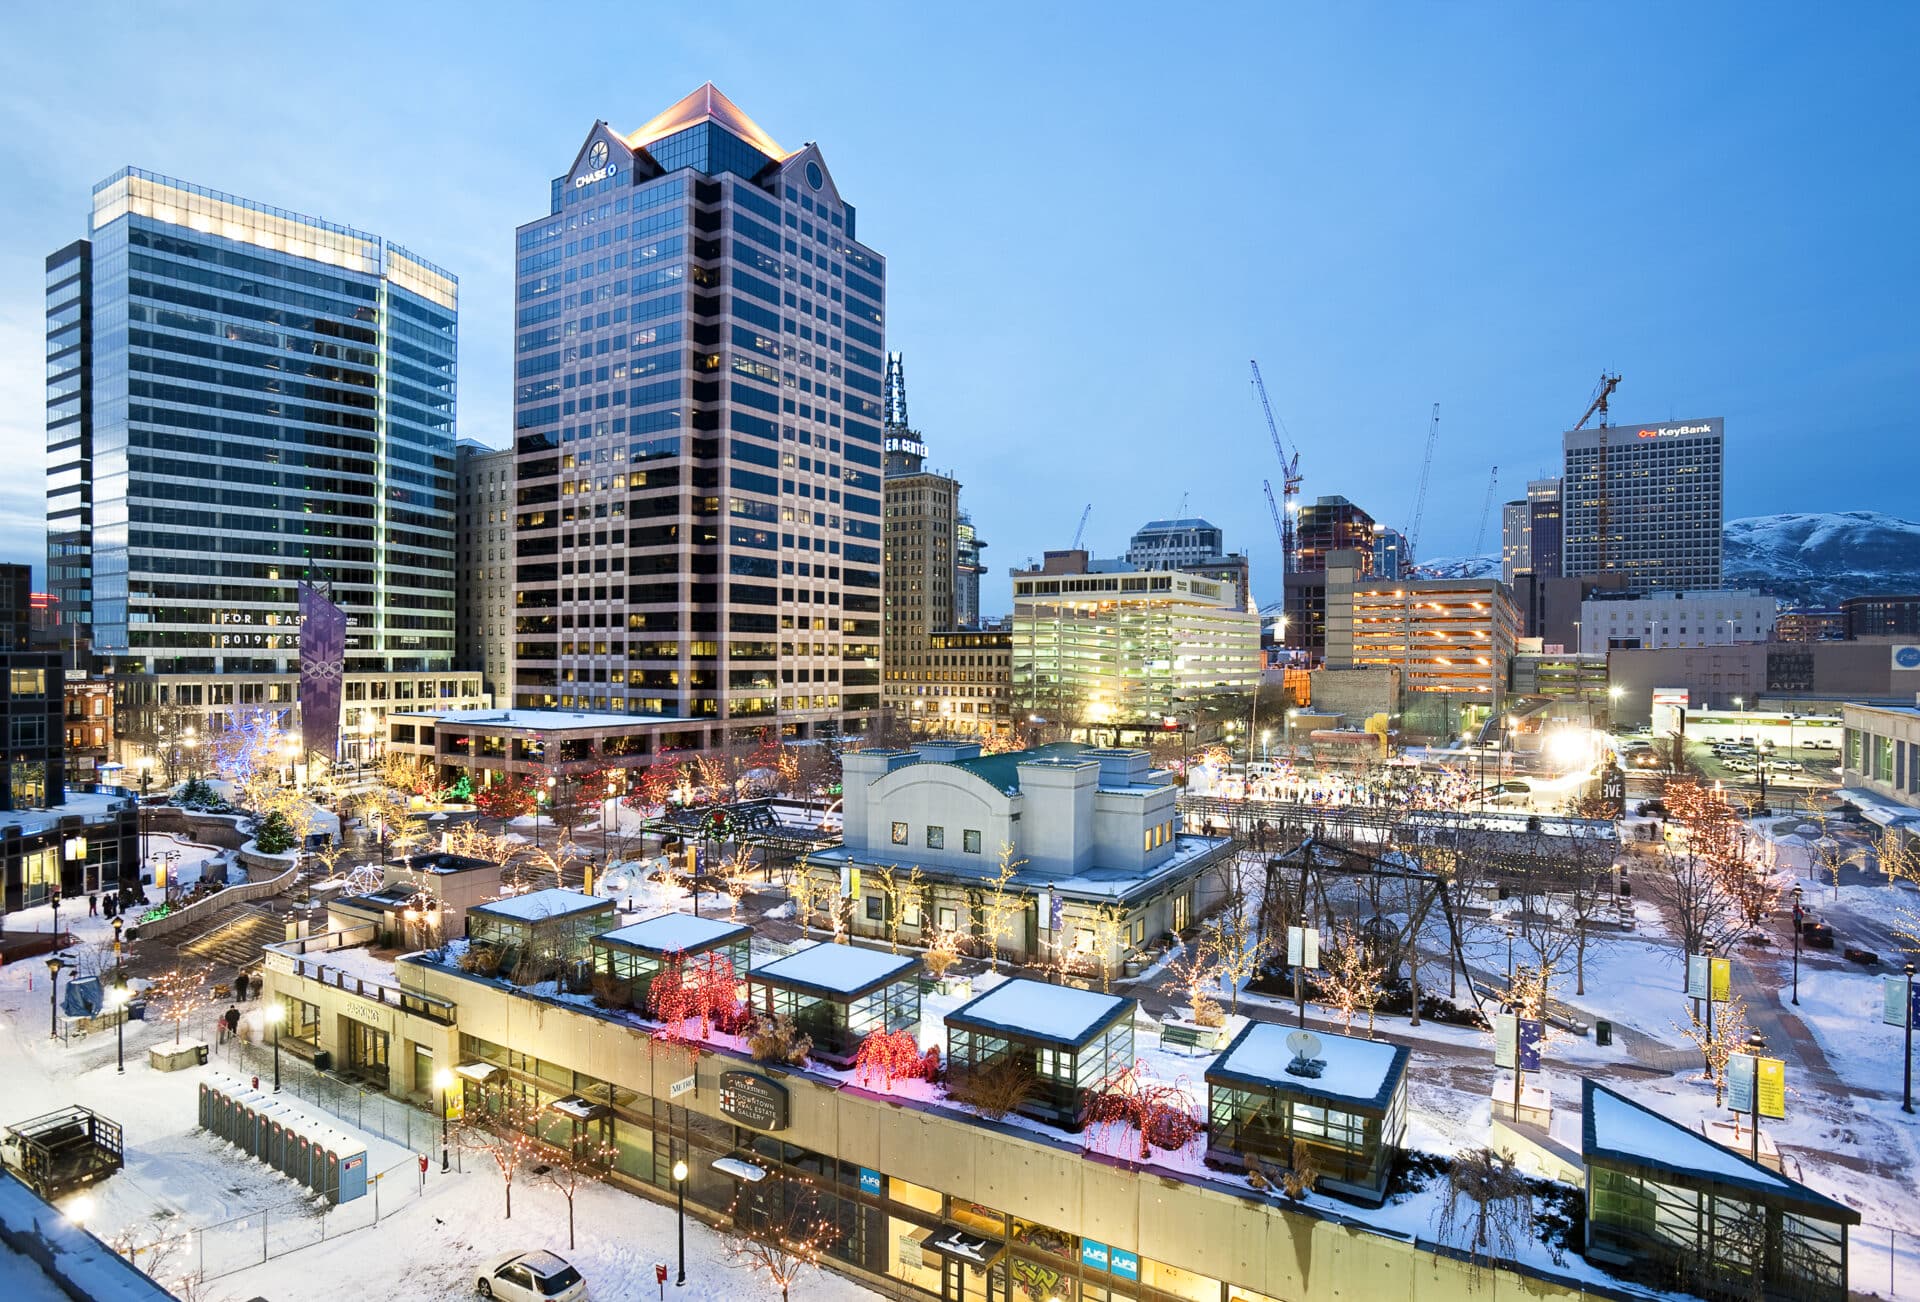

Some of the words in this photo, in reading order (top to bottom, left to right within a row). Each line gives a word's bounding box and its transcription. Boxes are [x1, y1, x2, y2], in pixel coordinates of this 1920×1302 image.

[576, 168, 607, 188] CHASE
[891, 351, 901, 423] WALKER
[1658, 424, 1711, 437] KeyBank
[224, 613, 251, 624] FOR
[346, 1001, 379, 1022] PARKING
[672, 1078, 695, 1093] METRO
[737, 1093, 775, 1110] DOWNTOWN
[737, 1108, 765, 1121] GALLERY
[754, 1106, 776, 1119] ESTATE
